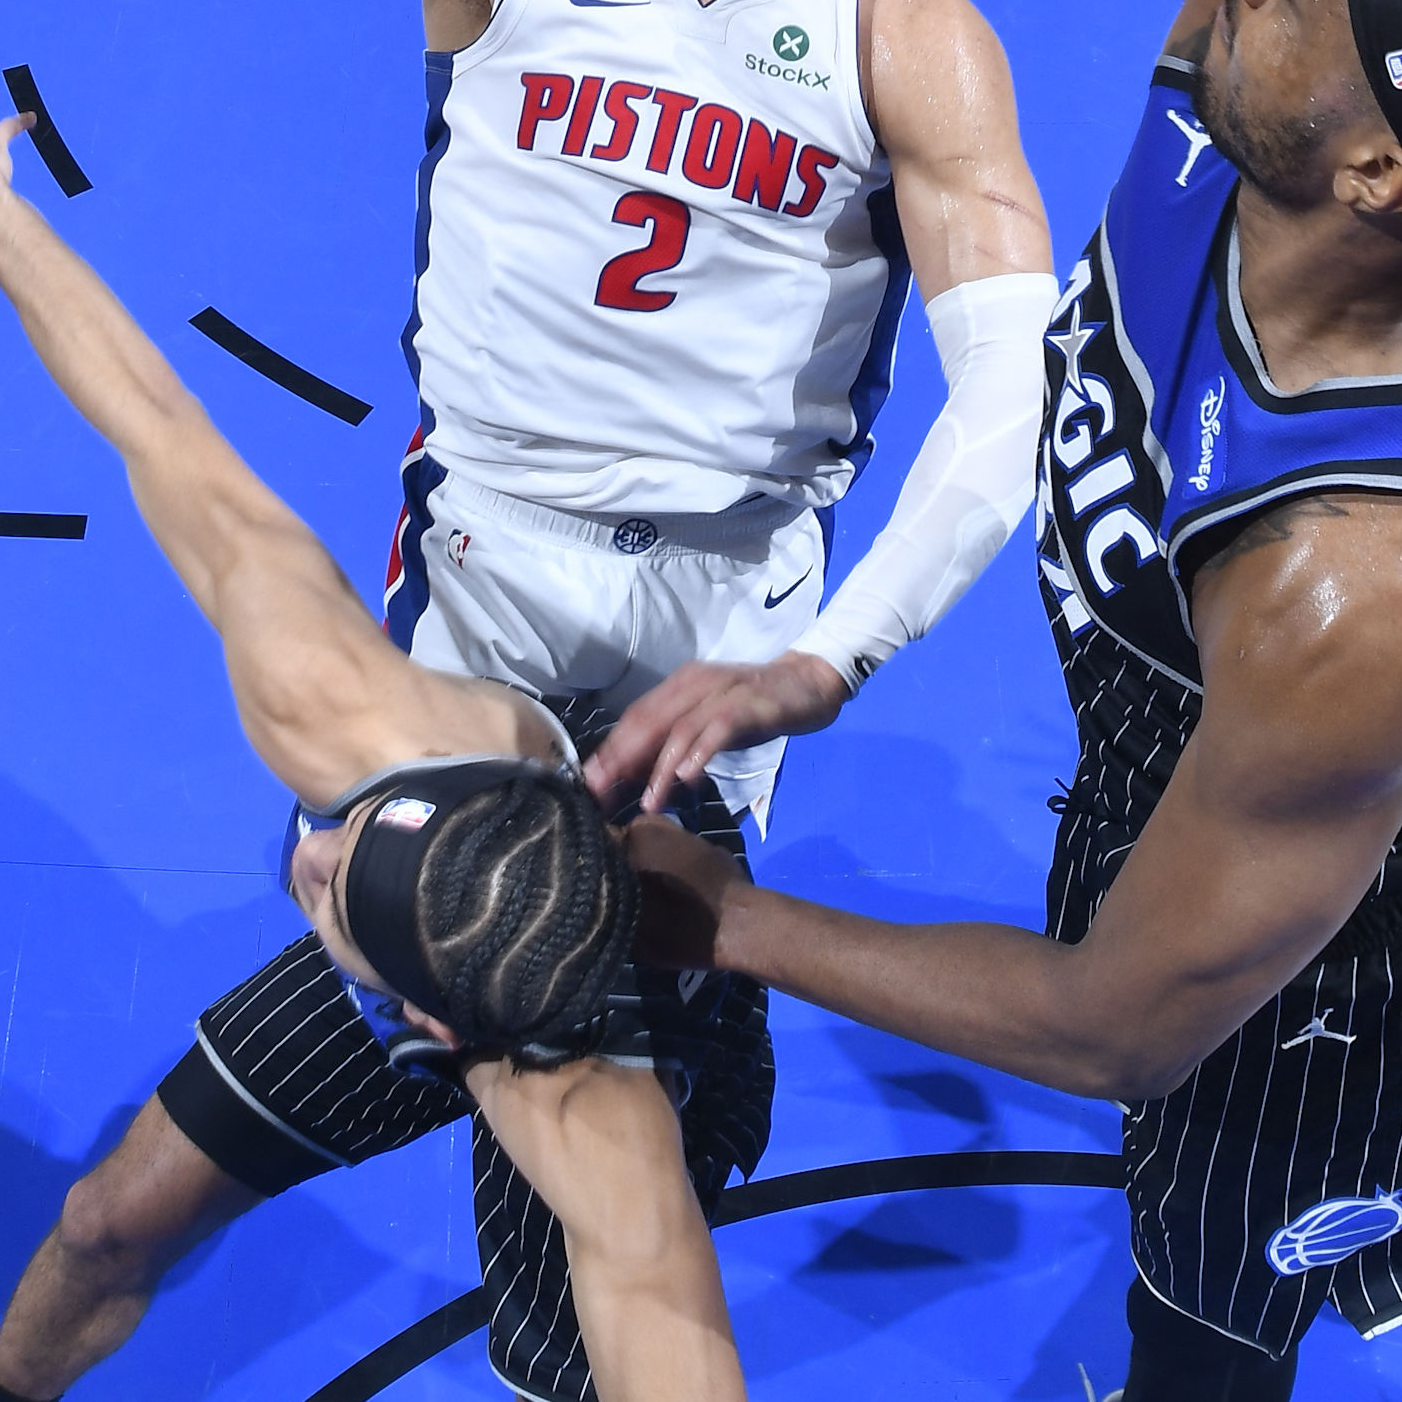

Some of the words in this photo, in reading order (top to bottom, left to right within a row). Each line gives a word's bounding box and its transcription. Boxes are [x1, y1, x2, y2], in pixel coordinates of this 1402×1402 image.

[745, 53, 831, 92] StockX
[517, 72, 840, 218] PISTONS
[594, 190, 692, 313] 2
[1188, 375, 1226, 492] Disney
